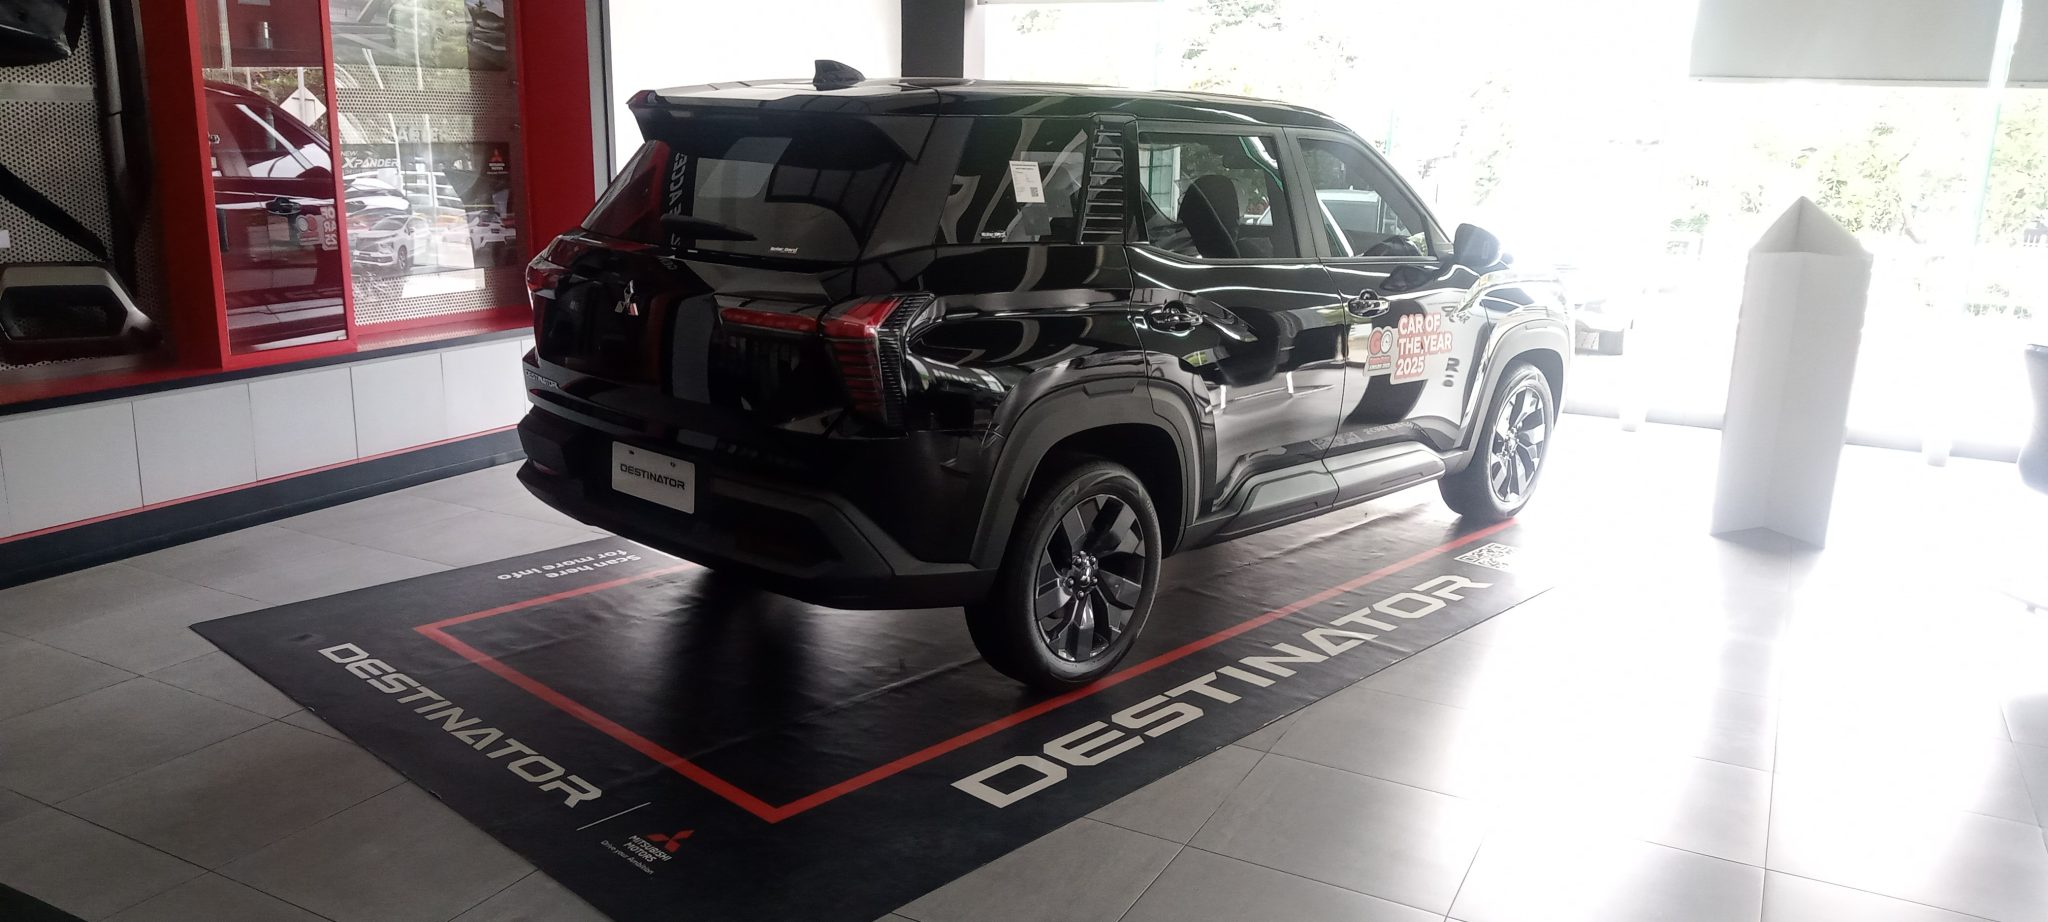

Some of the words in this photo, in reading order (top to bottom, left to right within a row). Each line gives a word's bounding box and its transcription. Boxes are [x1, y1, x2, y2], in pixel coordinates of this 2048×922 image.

[342, 156, 399, 169] XPANDER
[1399, 314, 1424, 335] CAR
[1425, 313, 1441, 332] OF
[1399, 335, 1423, 356] THE
[1422, 332, 1452, 353] YEAR
[1395, 356, 1425, 376] 2025
[525, 370, 560, 389] DESTINATOR
[619, 463, 686, 490] DESTINATOR
[542, 556, 596, 570] more
[593, 554, 642, 569] Scan
[598, 549, 628, 560] for
[545, 565, 594, 579] here
[951, 574, 1493, 808] DESTINATOR
[318, 642, 602, 808] DESTINATOR
[623, 841, 658, 862] MOTORS
[628, 834, 673, 861] MITSUBISHI
